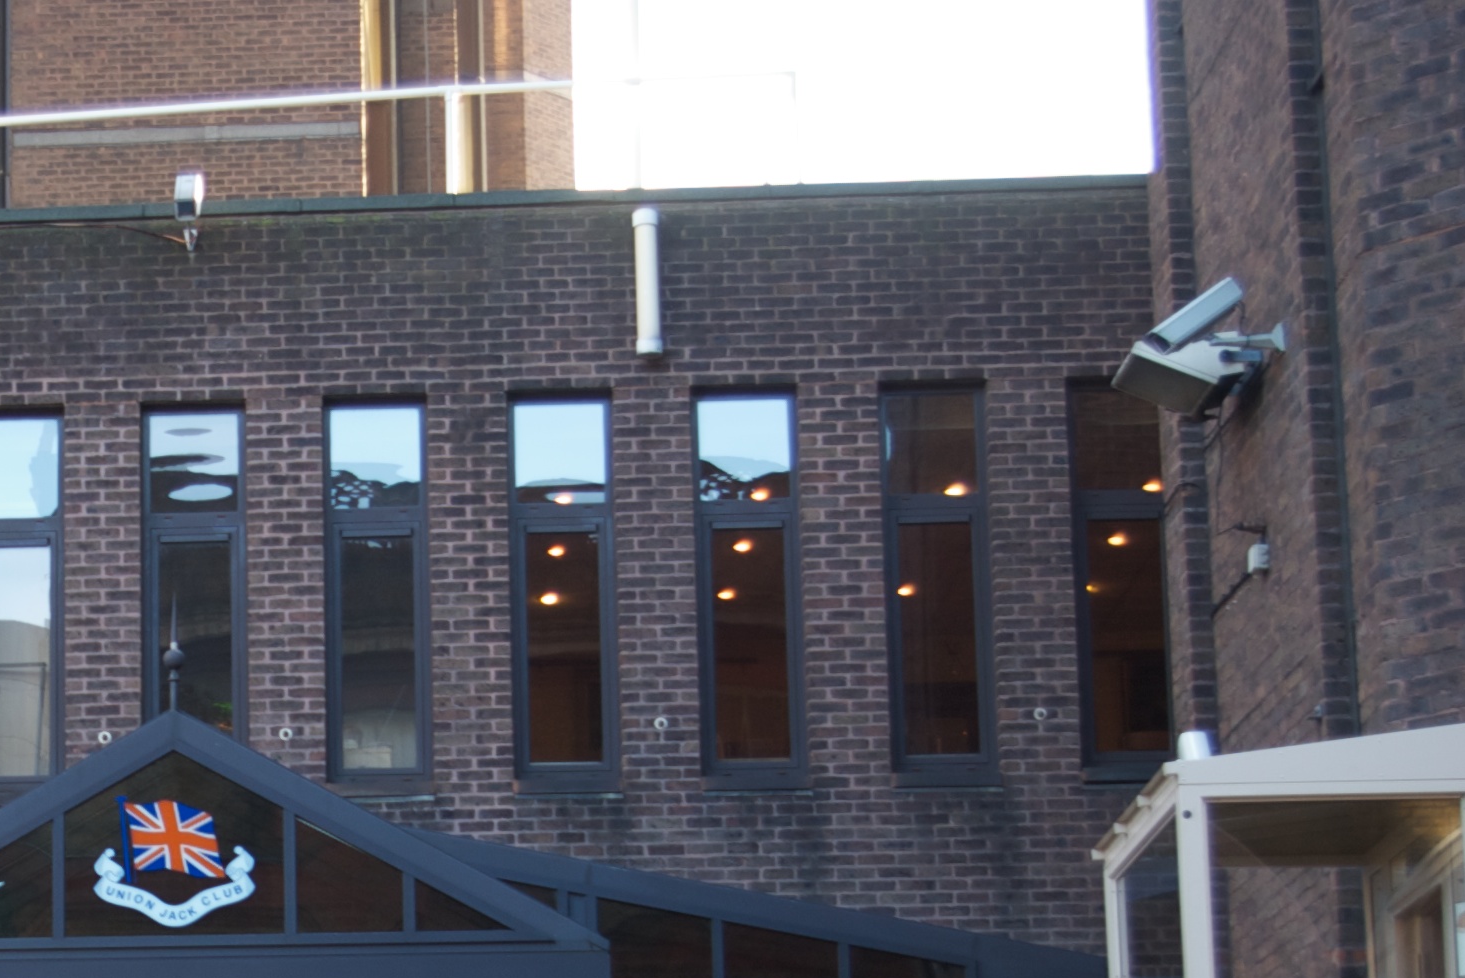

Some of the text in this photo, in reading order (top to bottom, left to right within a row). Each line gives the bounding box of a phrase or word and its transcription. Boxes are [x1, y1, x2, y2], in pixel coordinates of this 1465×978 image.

[106, 884, 243, 920] UNION JACK CLUB
